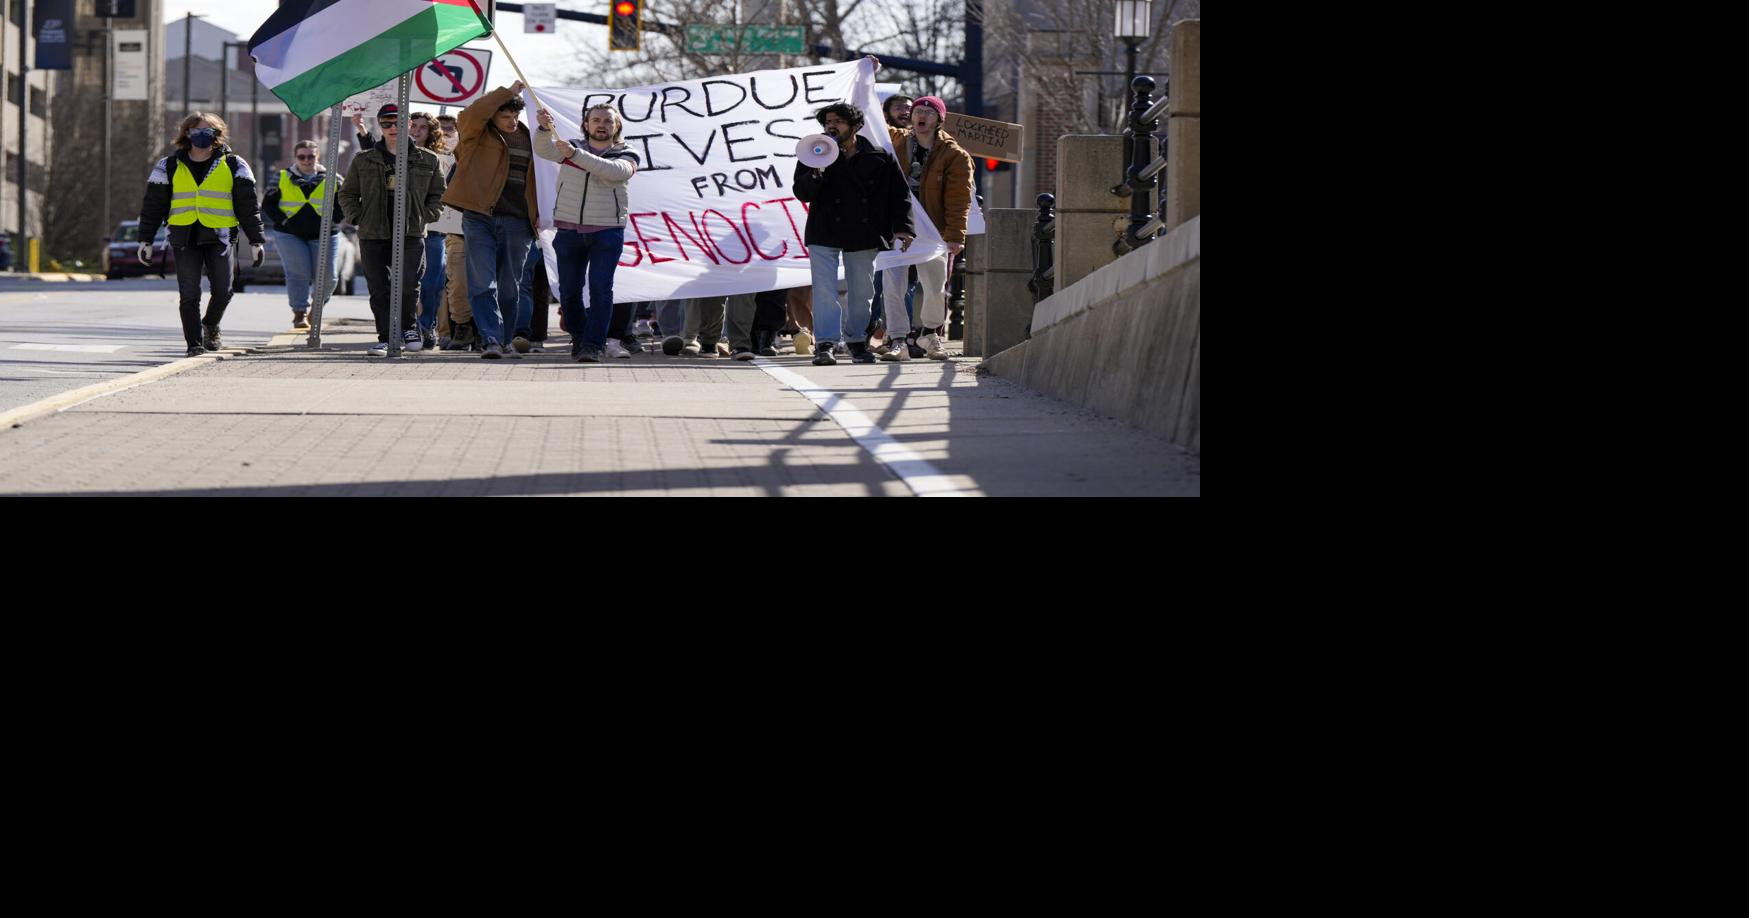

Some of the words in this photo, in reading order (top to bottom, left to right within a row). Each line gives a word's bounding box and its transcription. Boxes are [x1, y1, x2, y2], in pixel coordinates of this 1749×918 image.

[956, 117, 1009, 139] LOCKHEED
[957, 128, 1004, 147] MARTIN
[624, 116, 816, 172] IVES
[691, 164, 782, 198] FROM
